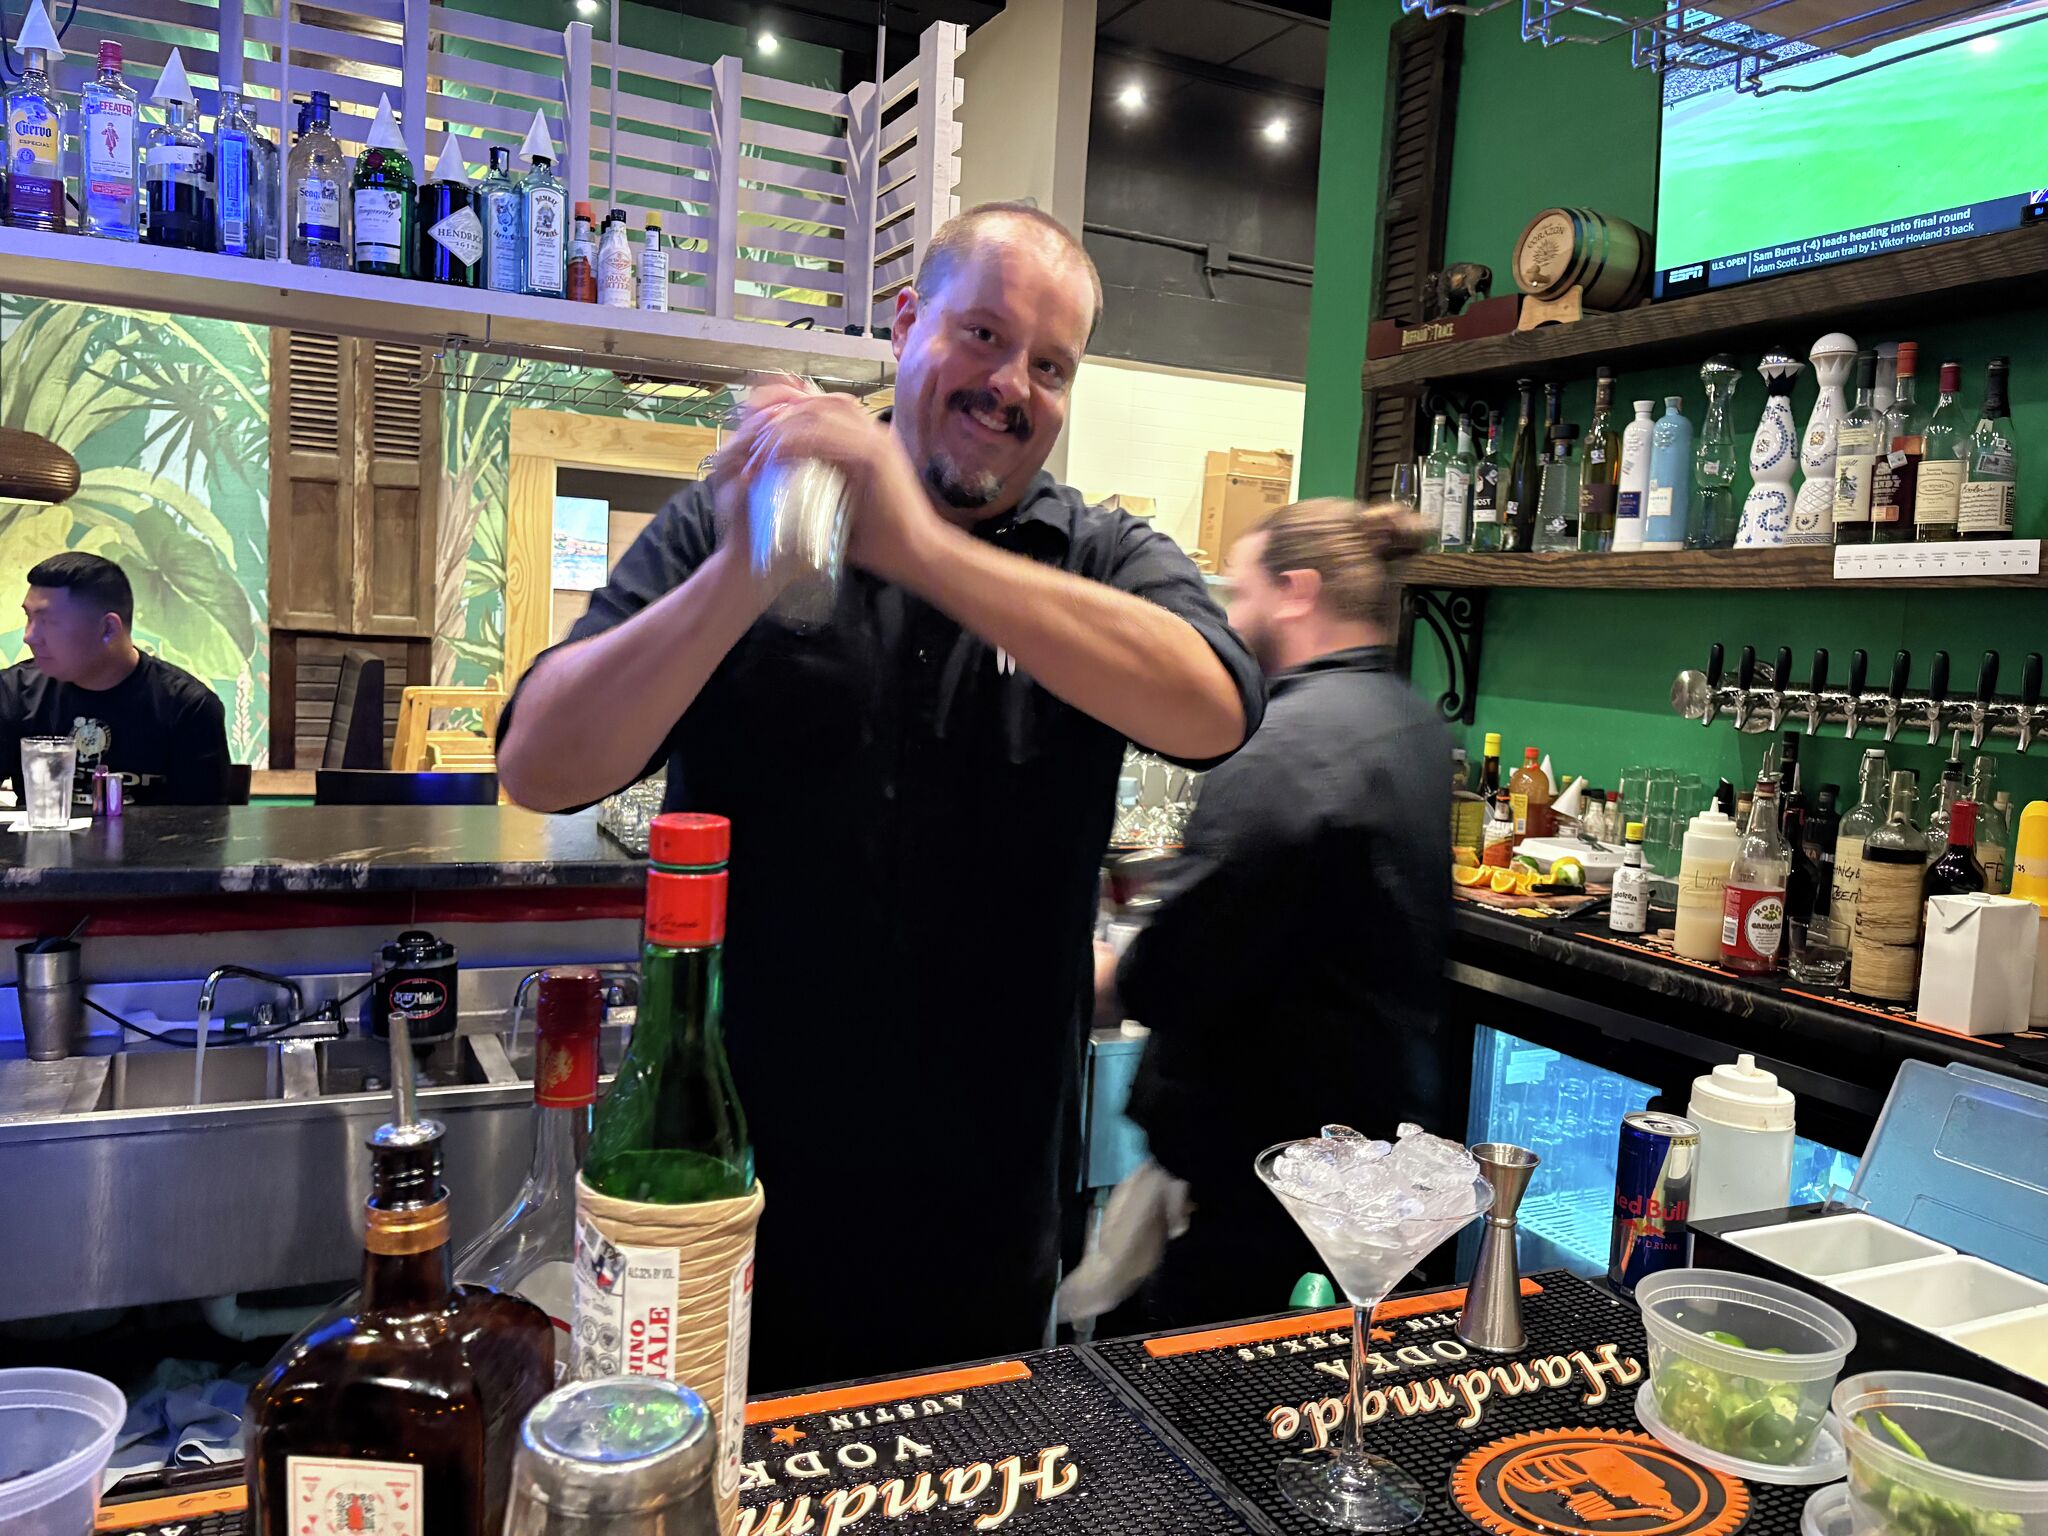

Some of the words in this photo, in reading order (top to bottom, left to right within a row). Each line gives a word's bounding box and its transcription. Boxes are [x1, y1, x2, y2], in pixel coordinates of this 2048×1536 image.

[100, 101, 132, 117] EFEATER
[15, 120, 52, 138] Cuervo
[1753, 250, 1773, 262] Sam
[1775, 245, 1801, 257] Burns
[1803, 239, 1821, 254] (-4)
[1822, 233, 1848, 248] leads
[1849, 226, 1889, 243] heading
[1890, 220, 1911, 234] into
[1913, 215, 1937, 230] final
[1938, 208, 1971, 224] round
[1753, 262, 1775, 274] Adam
[1776, 257, 1799, 270] Scott,
[1800, 254, 1813, 265] J.J.
[1814, 249, 1840, 263] Spaun
[1841, 242, 1858, 256] trail
[1859, 241, 1869, 254] by
[1879, 234, 1905, 249] Viktor
[1906, 227, 1942, 244] Hovland
[1943, 226, 1951, 237] 3
[1952, 221, 1975, 235] back
[1668, 265, 1704, 284] ESPN
[1711, 260, 1726, 271] U.S.
[1727, 256, 1747, 268] OPEN
[1645, 1199, 1688, 1222] Bull
[1645, 1239, 1678, 1251] DRINK
[1237, 1333, 1350, 1362] TEXAS
[1313, 1340, 1468, 1380] ODKA
[828, 1394, 965, 1432] AUSTIN
[1265, 1343, 1642, 1453] Handmade
[738, 1434, 934, 1490] VODK
[735, 1444, 1079, 1536] Handm
